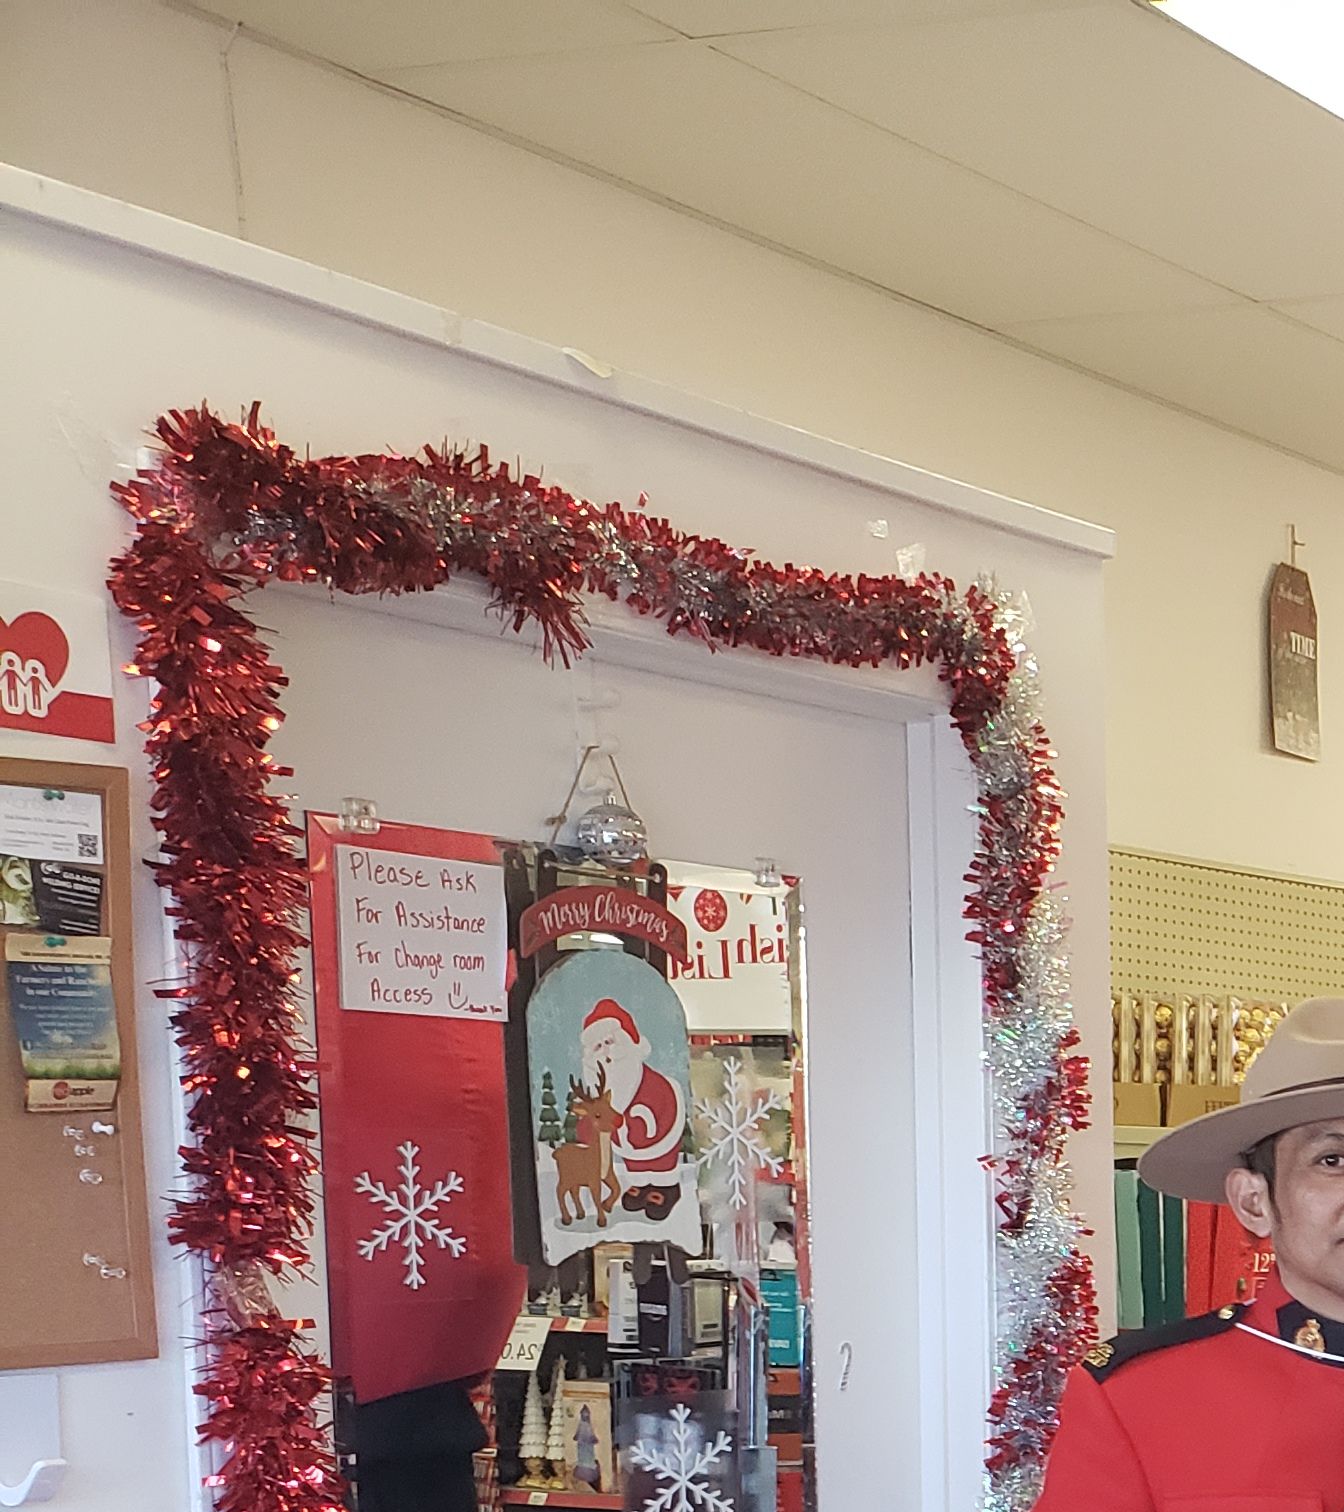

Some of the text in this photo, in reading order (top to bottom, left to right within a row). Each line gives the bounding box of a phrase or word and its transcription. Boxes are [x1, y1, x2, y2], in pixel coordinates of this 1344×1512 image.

[349, 851, 477, 893] Please Ask
[355, 897, 486, 933] For Assistance
[538, 892, 669, 942] Merry Christmas
[356, 941, 381, 964] For
[453, 954, 485, 972] room
[370, 978, 433, 1005] Access
